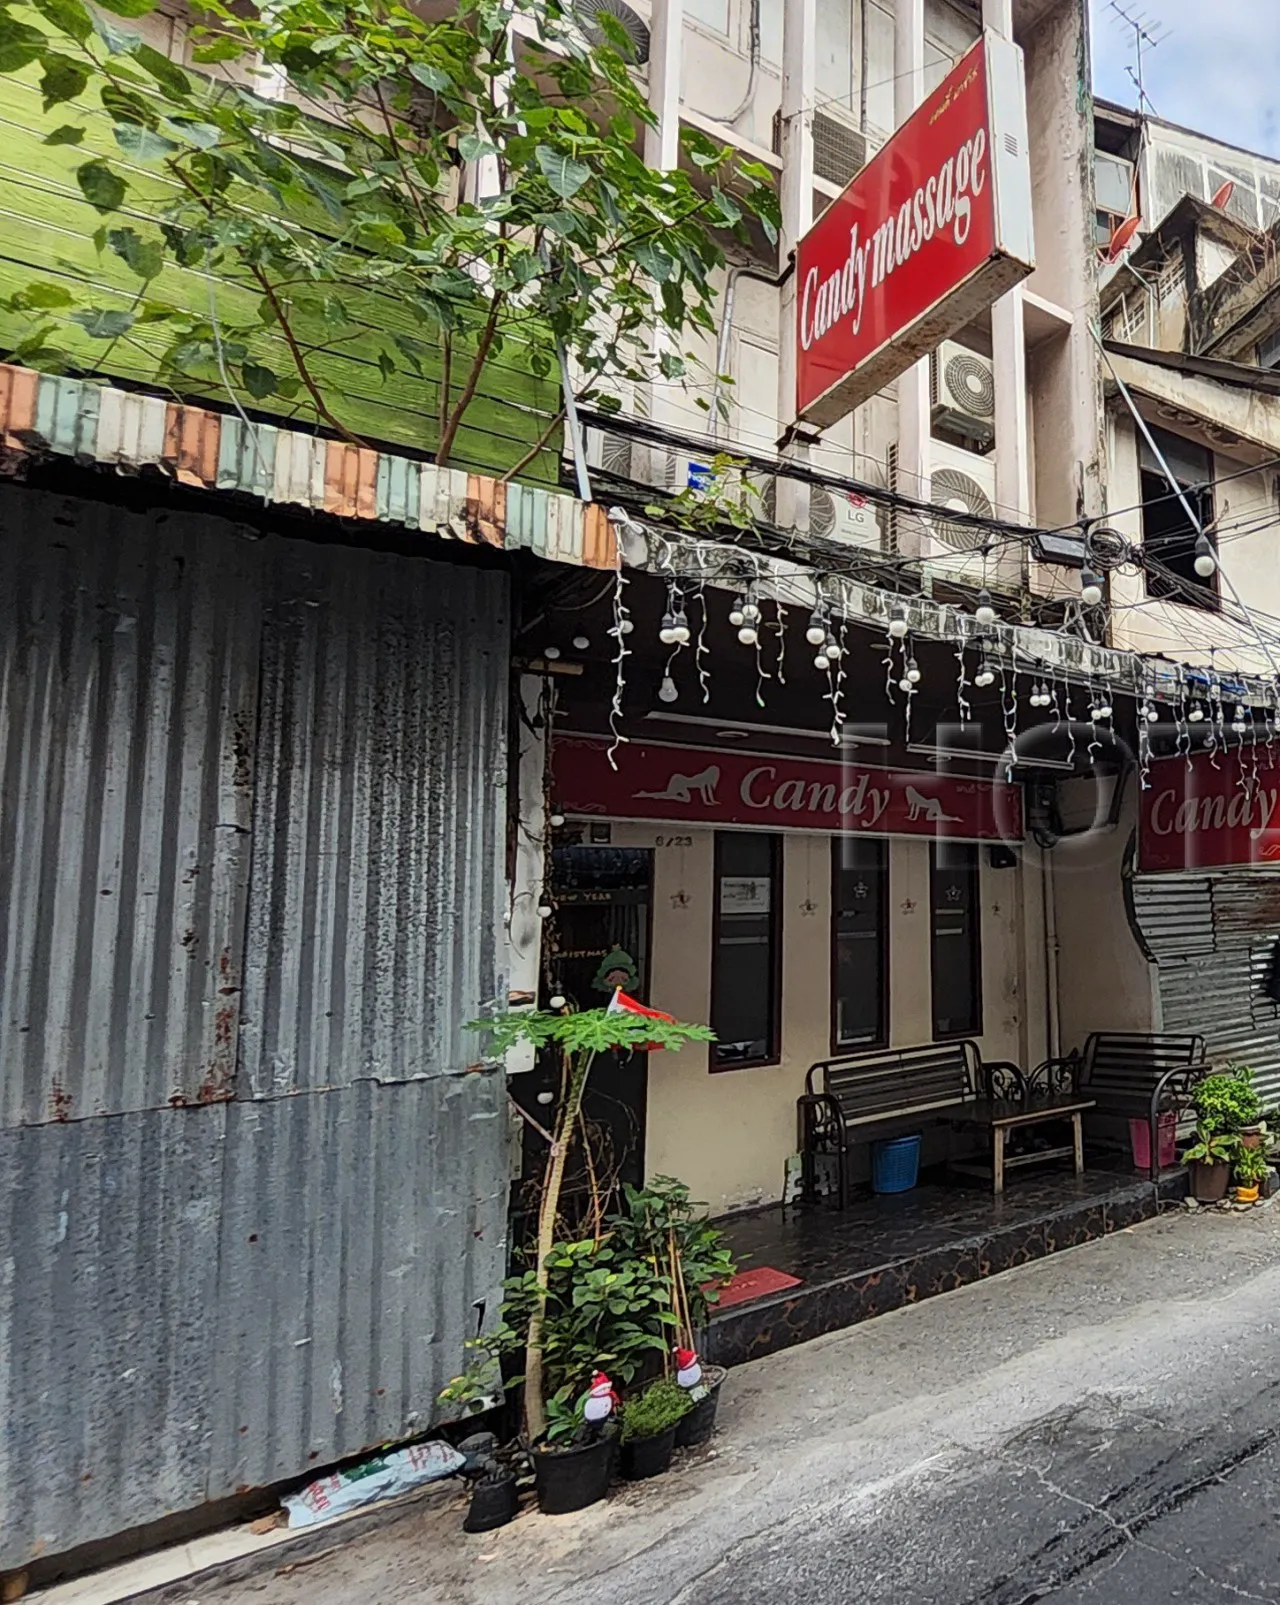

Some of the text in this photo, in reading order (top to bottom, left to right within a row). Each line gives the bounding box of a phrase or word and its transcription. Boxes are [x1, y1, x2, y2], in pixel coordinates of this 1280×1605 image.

[800, 127, 987, 352] Candy massage
[847, 509, 865, 523] LG
[740, 765, 890, 828] Candy
[1151, 776, 1278, 840] Candy
